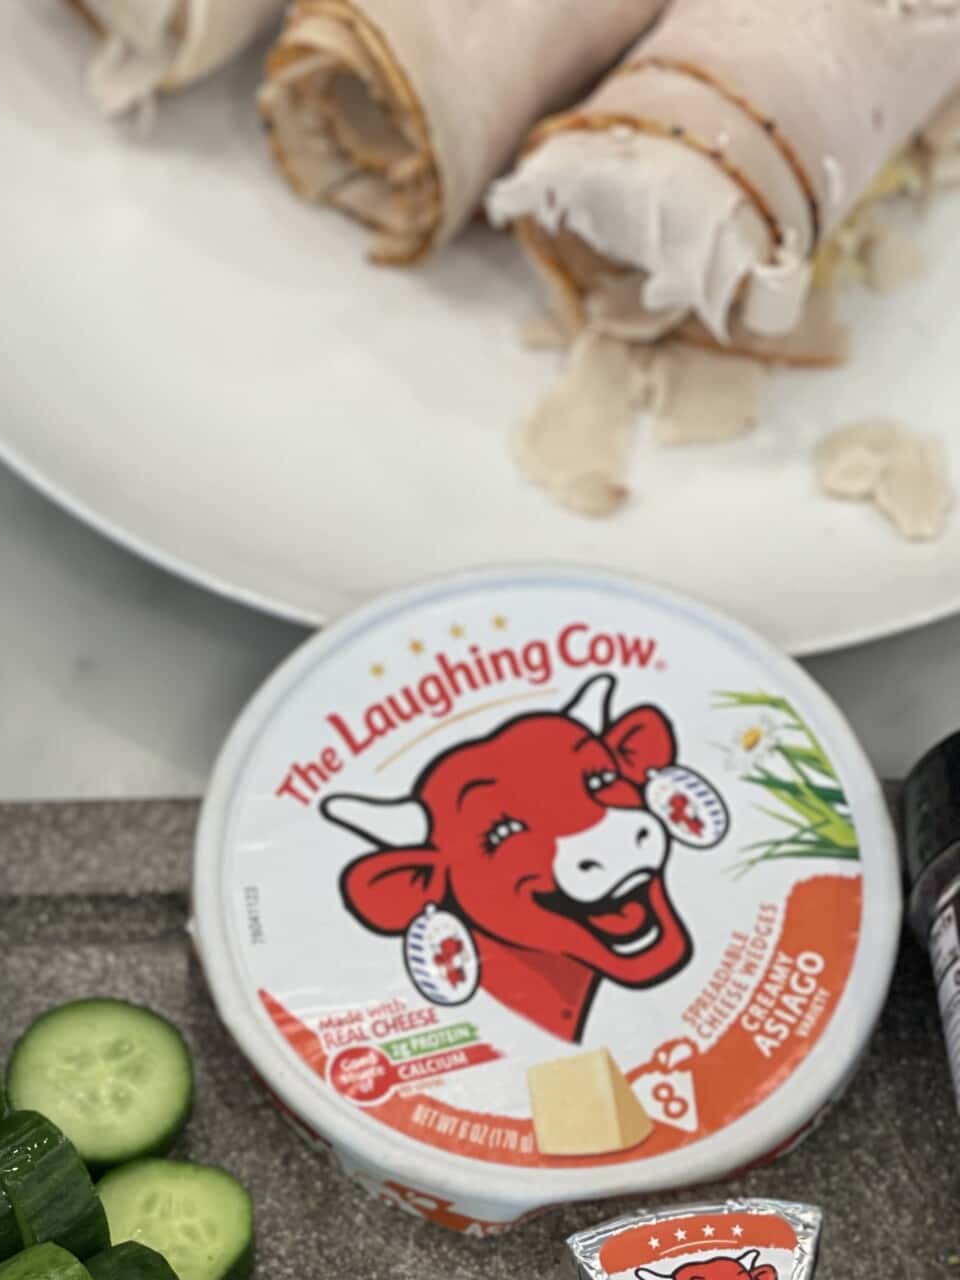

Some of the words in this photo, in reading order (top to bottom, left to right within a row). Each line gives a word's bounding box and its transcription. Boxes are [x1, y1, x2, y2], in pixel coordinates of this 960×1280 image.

[276, 746, 344, 806] The
[326, 638, 553, 756] Laughing
[557, 622, 657, 668] Cow
[682, 930, 749, 1027] SPREADABLE
[696, 978, 750, 1040] CHEESE
[742, 901, 779, 977] WEDGES
[740, 951, 795, 1032] CREAMY
[319, 1009, 364, 1031] Made
[753, 951, 825, 1058] ASIAGO
[323, 1025, 370, 1049] REAL
[370, 1007, 439, 1039] CHEESE
[408, 1025, 472, 1052] PROTEIN
[397, 1050, 468, 1081] CALCIUM
[651, 1082, 689, 1119] 8
[411, 1103, 439, 1130] NET
[468, 1122, 489, 1145] OZ
